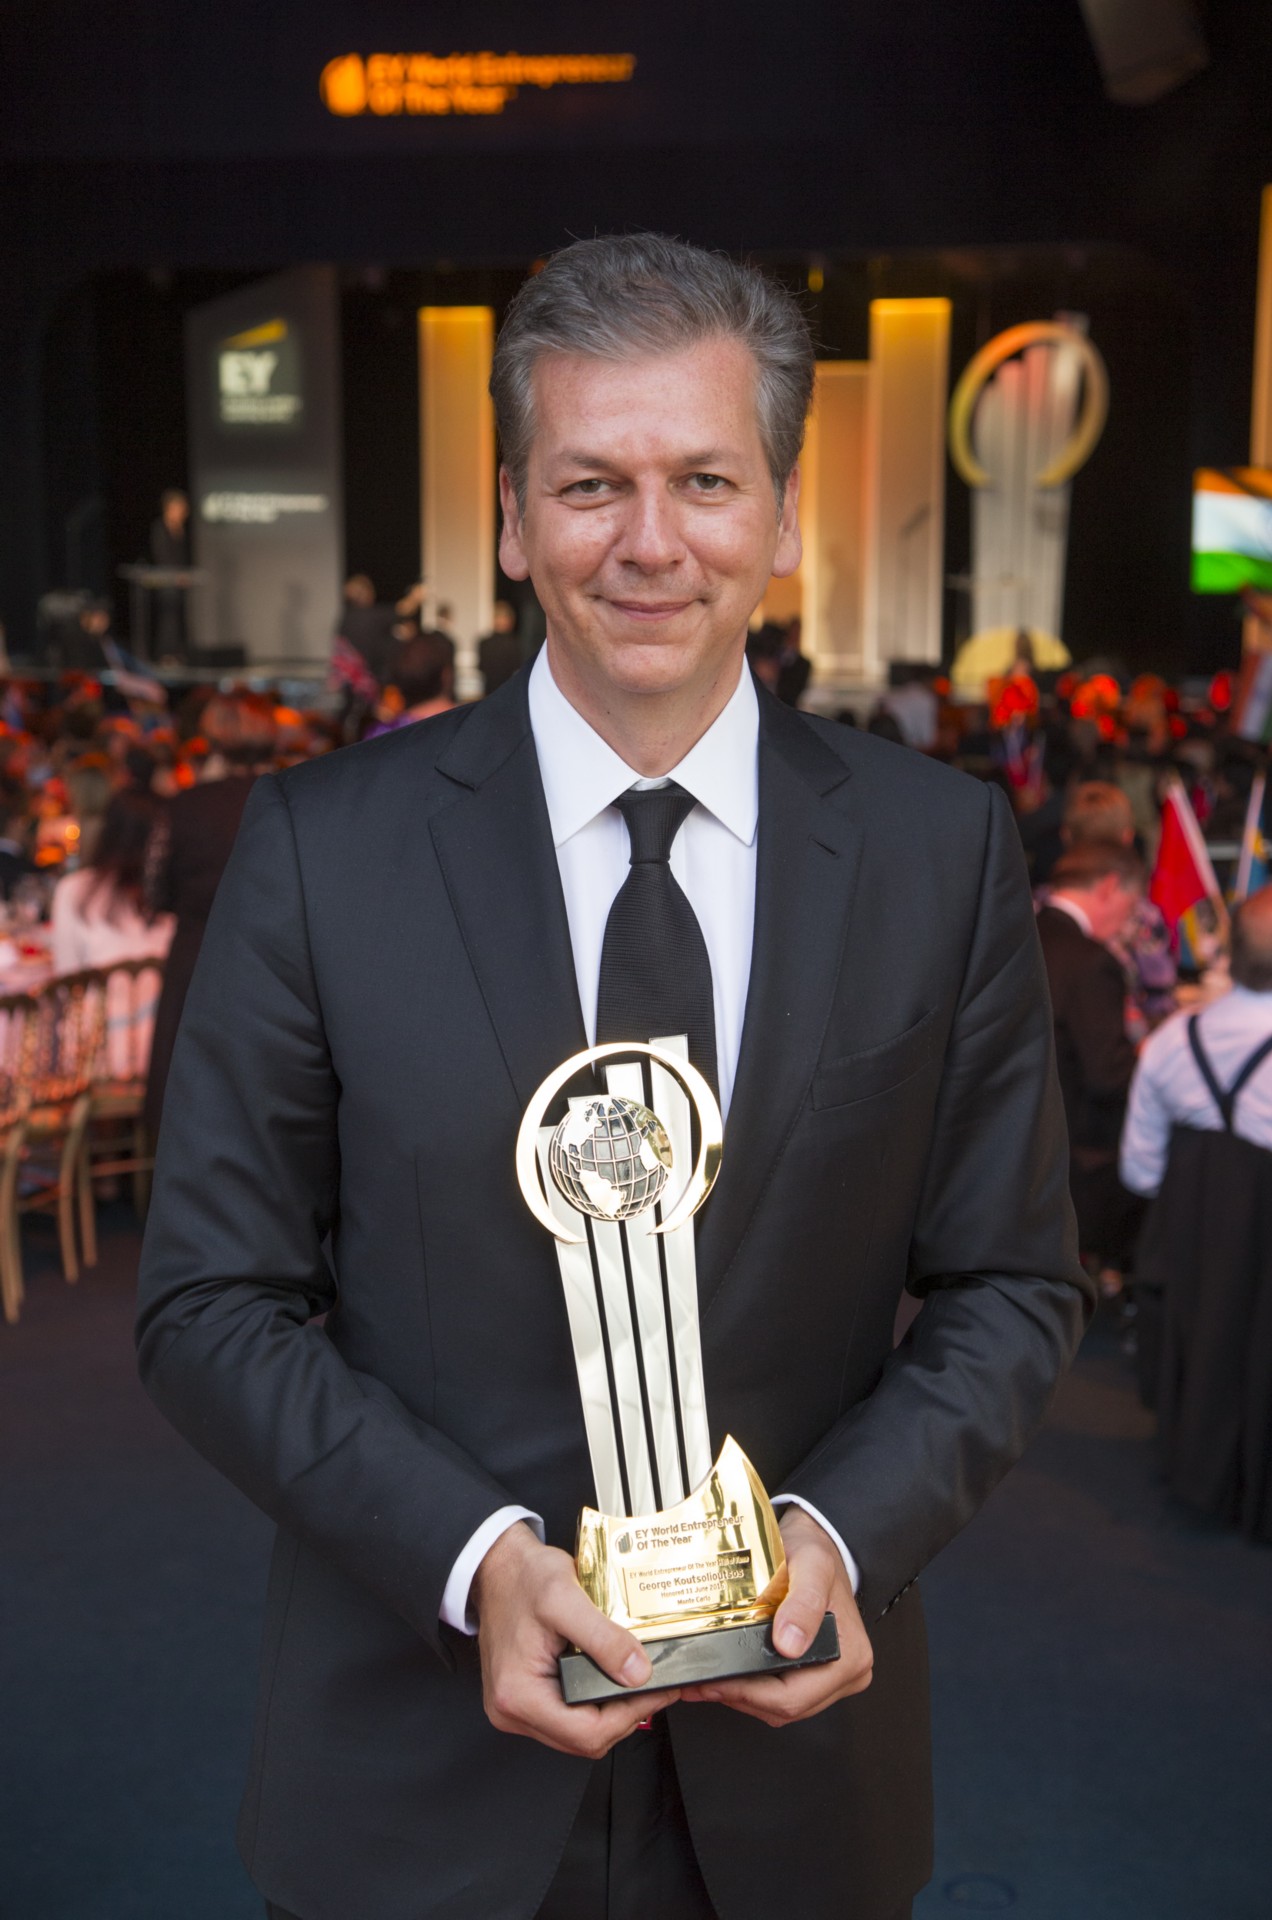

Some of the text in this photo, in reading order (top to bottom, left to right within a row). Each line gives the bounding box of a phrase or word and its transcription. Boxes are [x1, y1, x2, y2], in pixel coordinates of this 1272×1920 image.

[219, 350, 275, 395] EY
[635, 1515, 744, 1540] EY World Entrepreneur
[636, 1535, 693, 1551] Of The Year
[638, 1568, 745, 1591] George Koutsolioutsos
[694, 1585, 708, 1593] June
